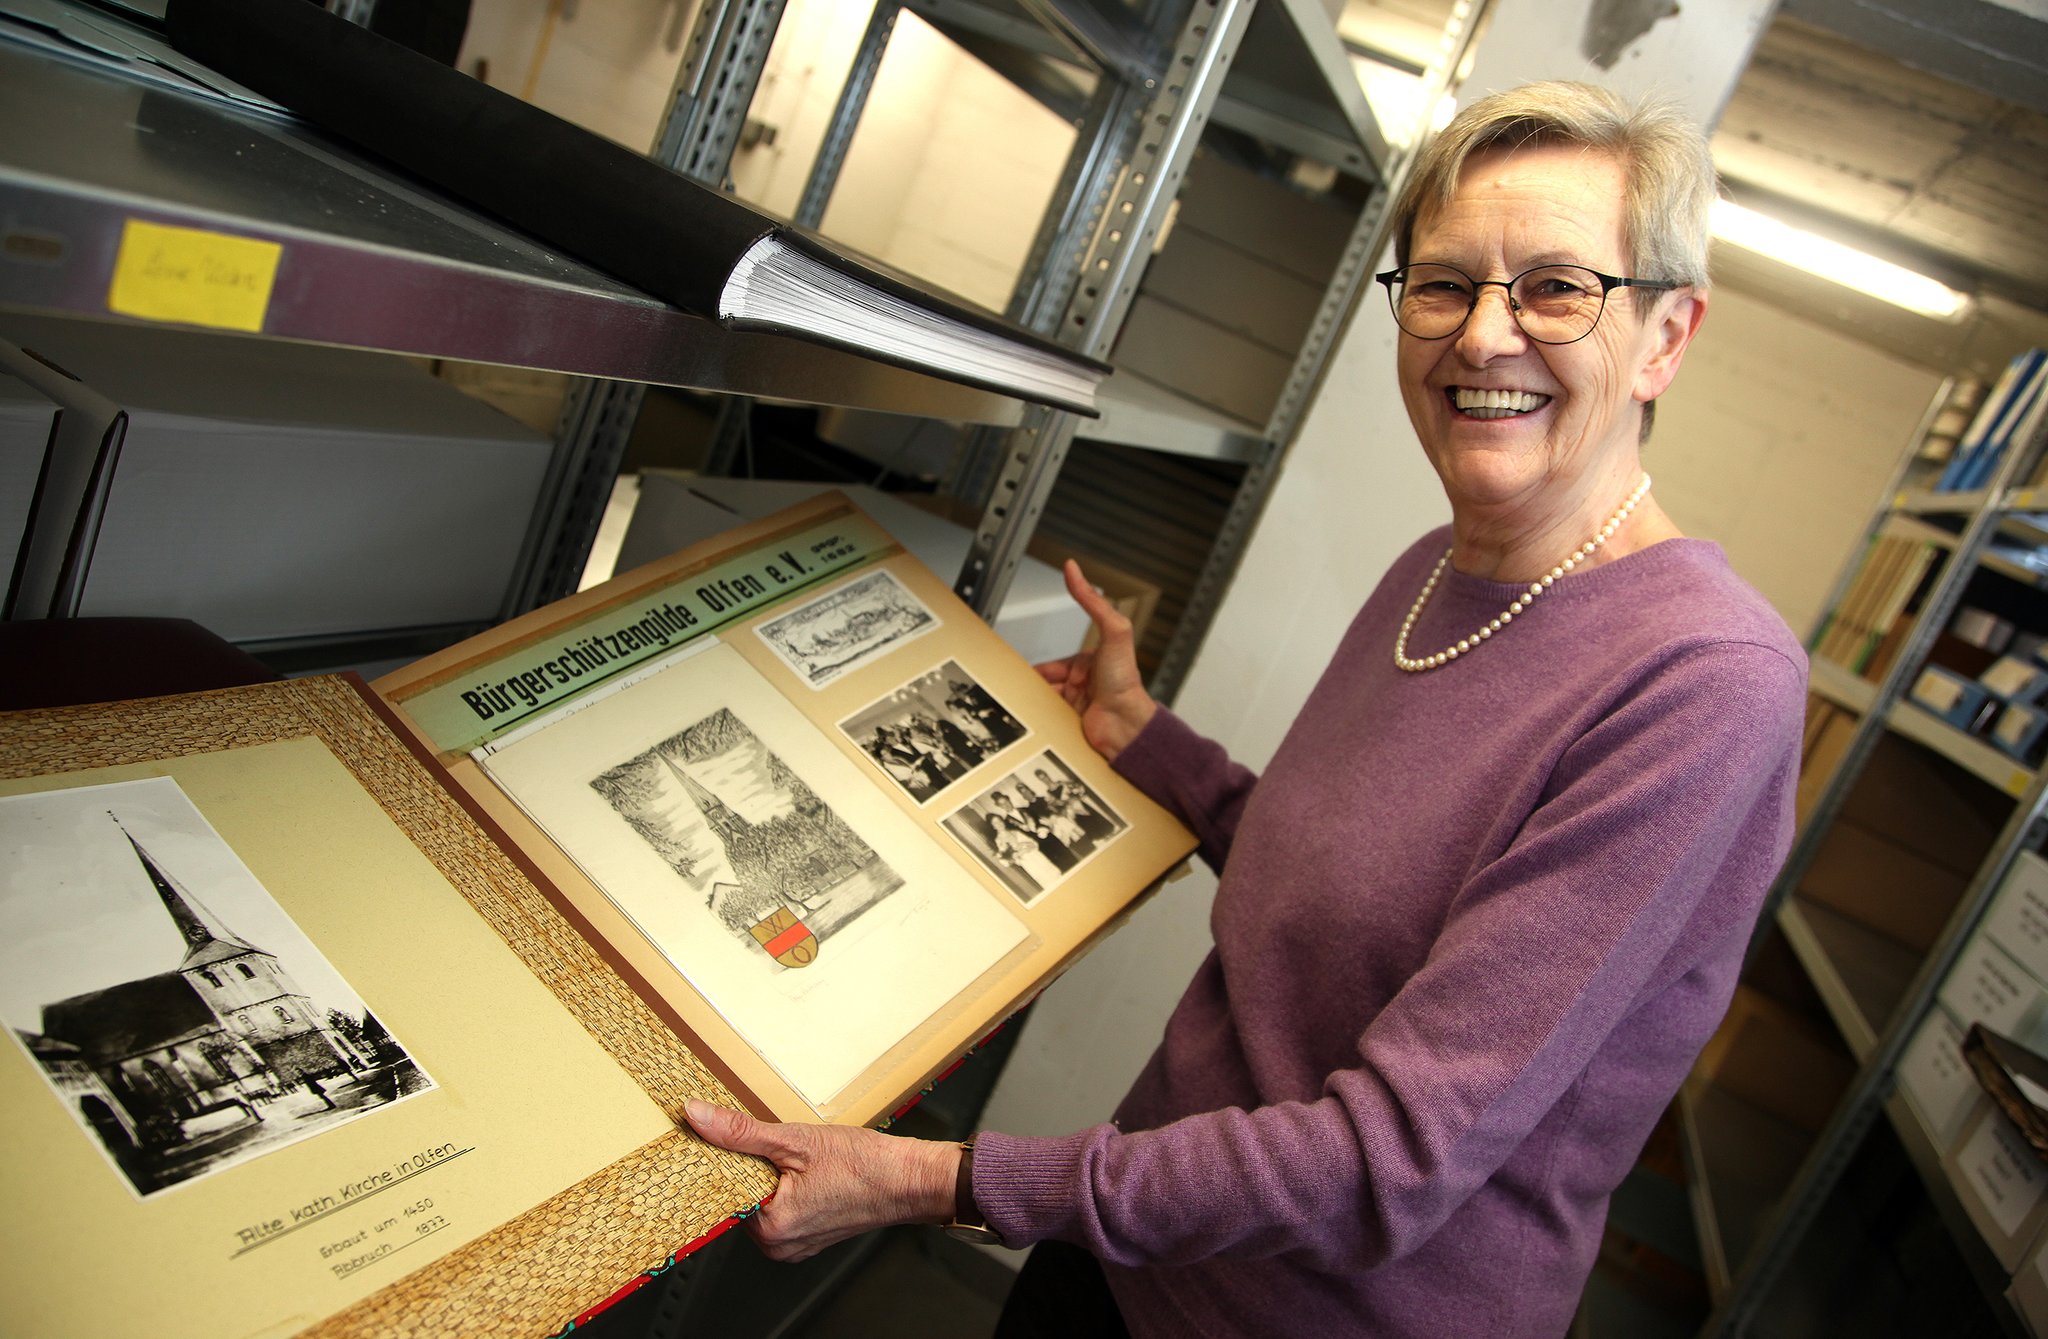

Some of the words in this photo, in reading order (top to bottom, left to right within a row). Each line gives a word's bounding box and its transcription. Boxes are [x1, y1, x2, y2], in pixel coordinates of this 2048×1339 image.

[461, 598, 698, 721] Bürgerschützengilde
[696, 573, 766, 612] Olfen
[764, 550, 814, 584] e.V.
[236, 1219, 284, 1245] Alte
[290, 1195, 341, 1222] kath.
[340, 1171, 393, 1200] Kirche
[395, 1163, 414, 1177] in
[412, 1141, 456, 1168] Olfen
[319, 1230, 368, 1259] Erbaut
[374, 1217, 398, 1234] um
[403, 1197, 434, 1219] 1450
[332, 1242, 392, 1276] Abbruch
[415, 1215, 445, 1236] 1877
